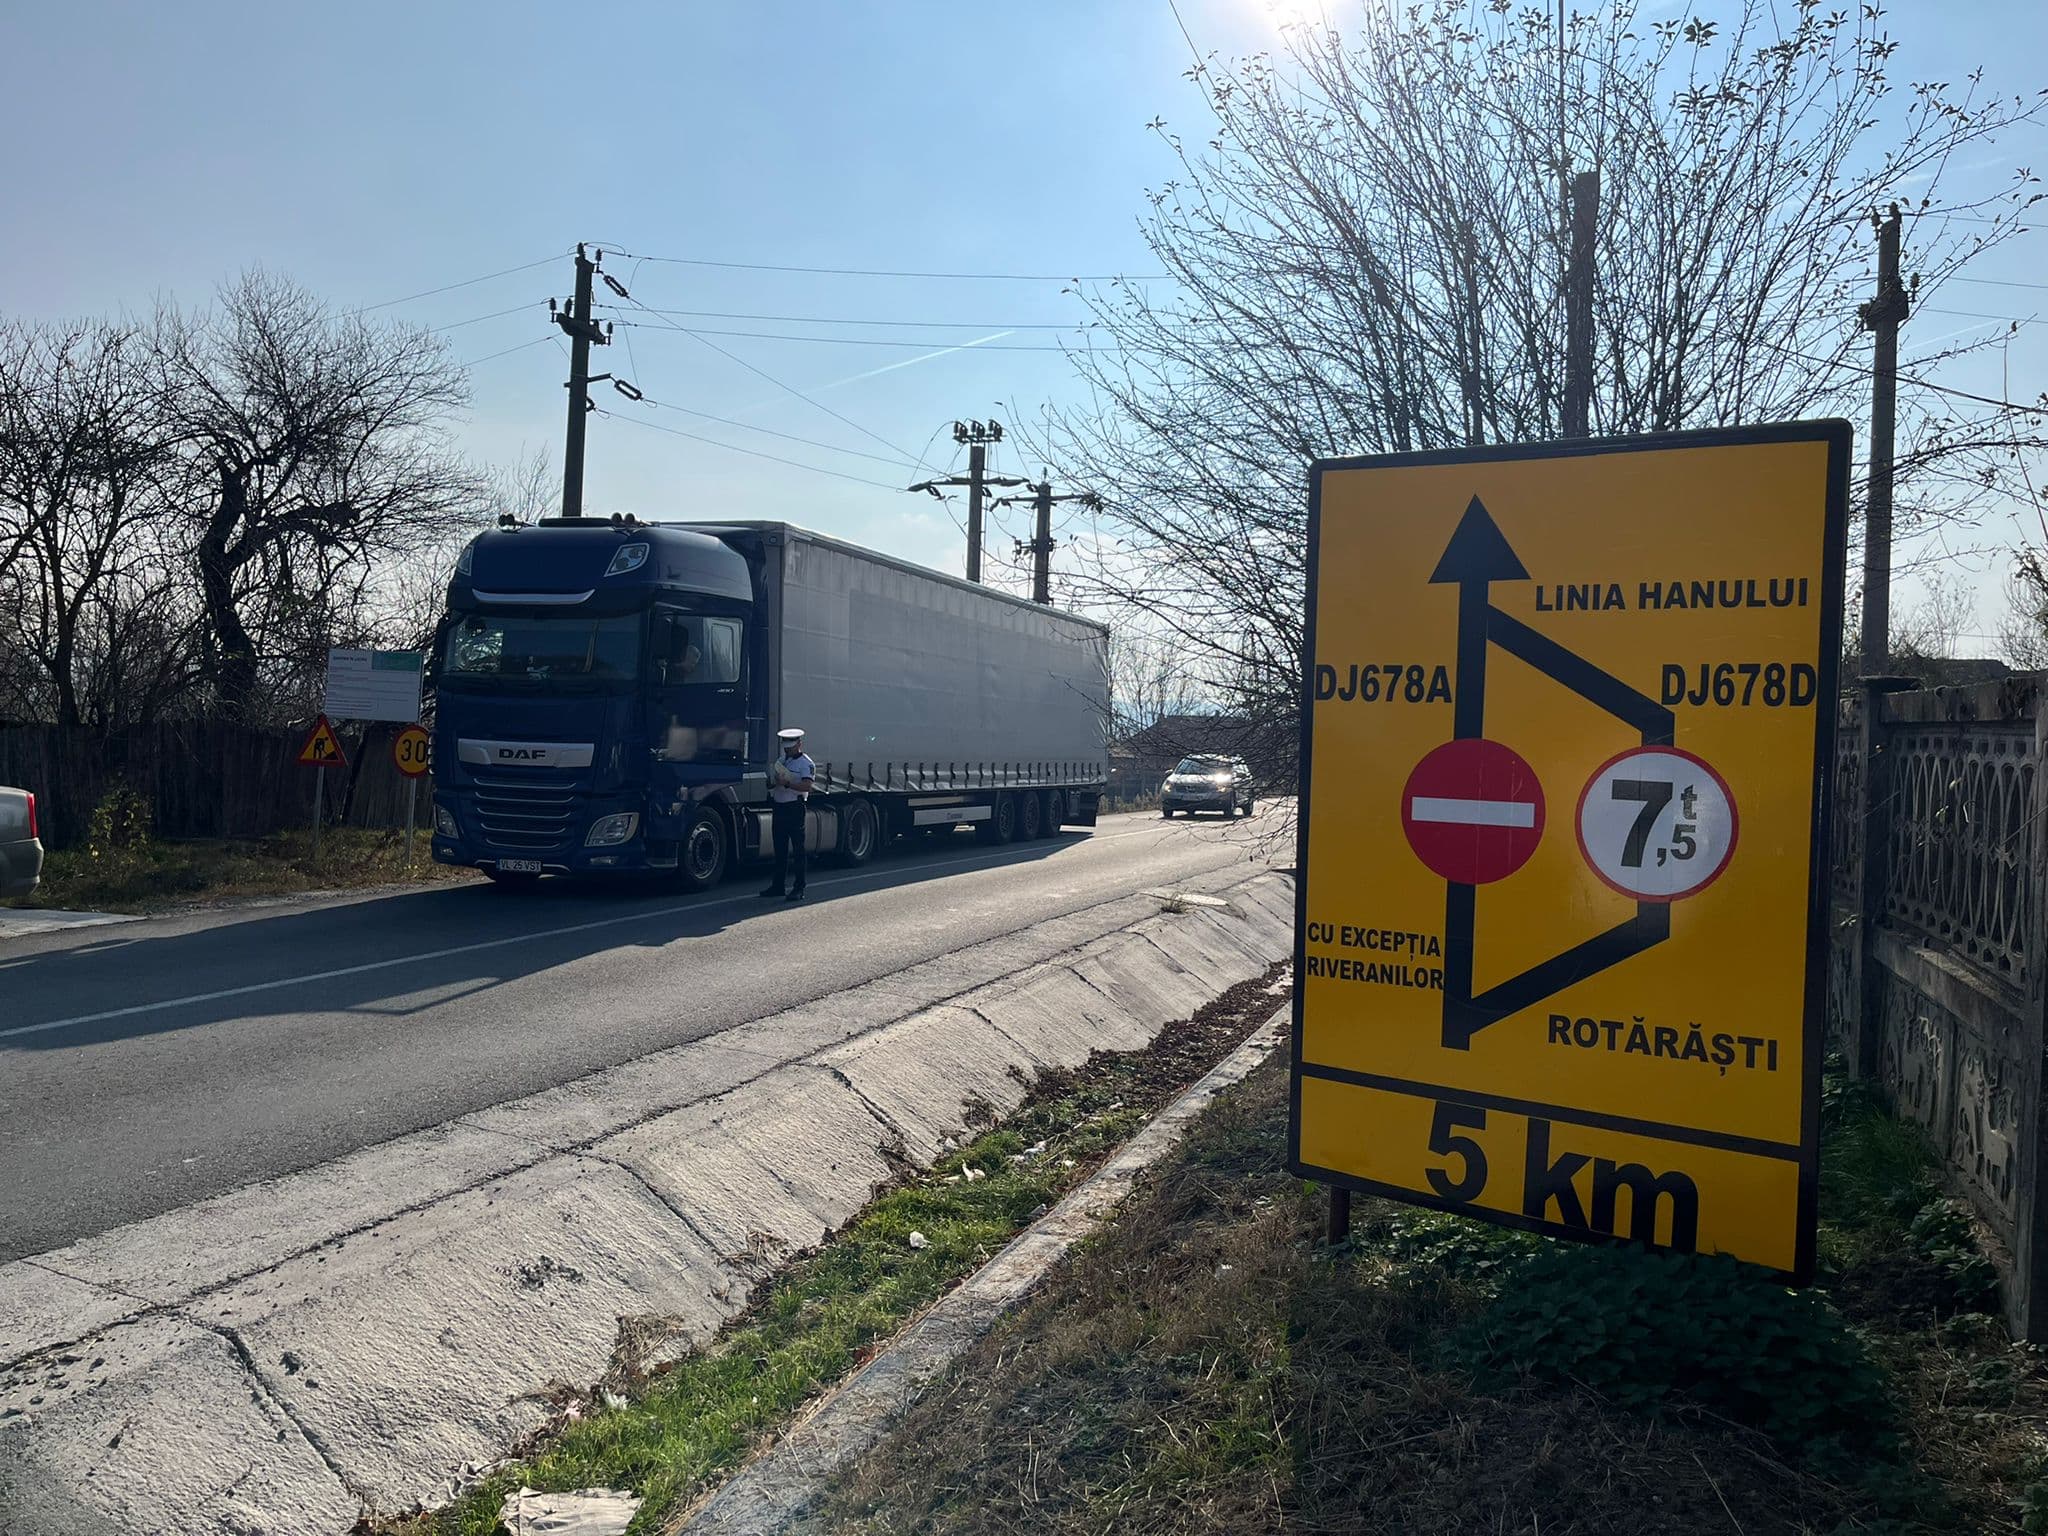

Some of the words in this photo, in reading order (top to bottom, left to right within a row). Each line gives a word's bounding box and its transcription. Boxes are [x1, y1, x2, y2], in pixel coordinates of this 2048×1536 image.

[1535, 582, 1626, 612] LINIA
[1638, 577, 1809, 609] HANULUI
[1314, 663, 1453, 704] DJ678A
[1660, 662, 1818, 707] DJ678D
[400, 738, 427, 763] 30
[499, 748, 547, 760] DAF
[1307, 922, 1334, 944] CU
[1340, 925, 1441, 962] EXCEPȚIA
[1306, 955, 1444, 990] RIVERANILOR
[1547, 1013, 1778, 1077] ROTĂRĂȘTI
[1425, 1100, 1488, 1202] 5
[1522, 1117, 1699, 1254] km
